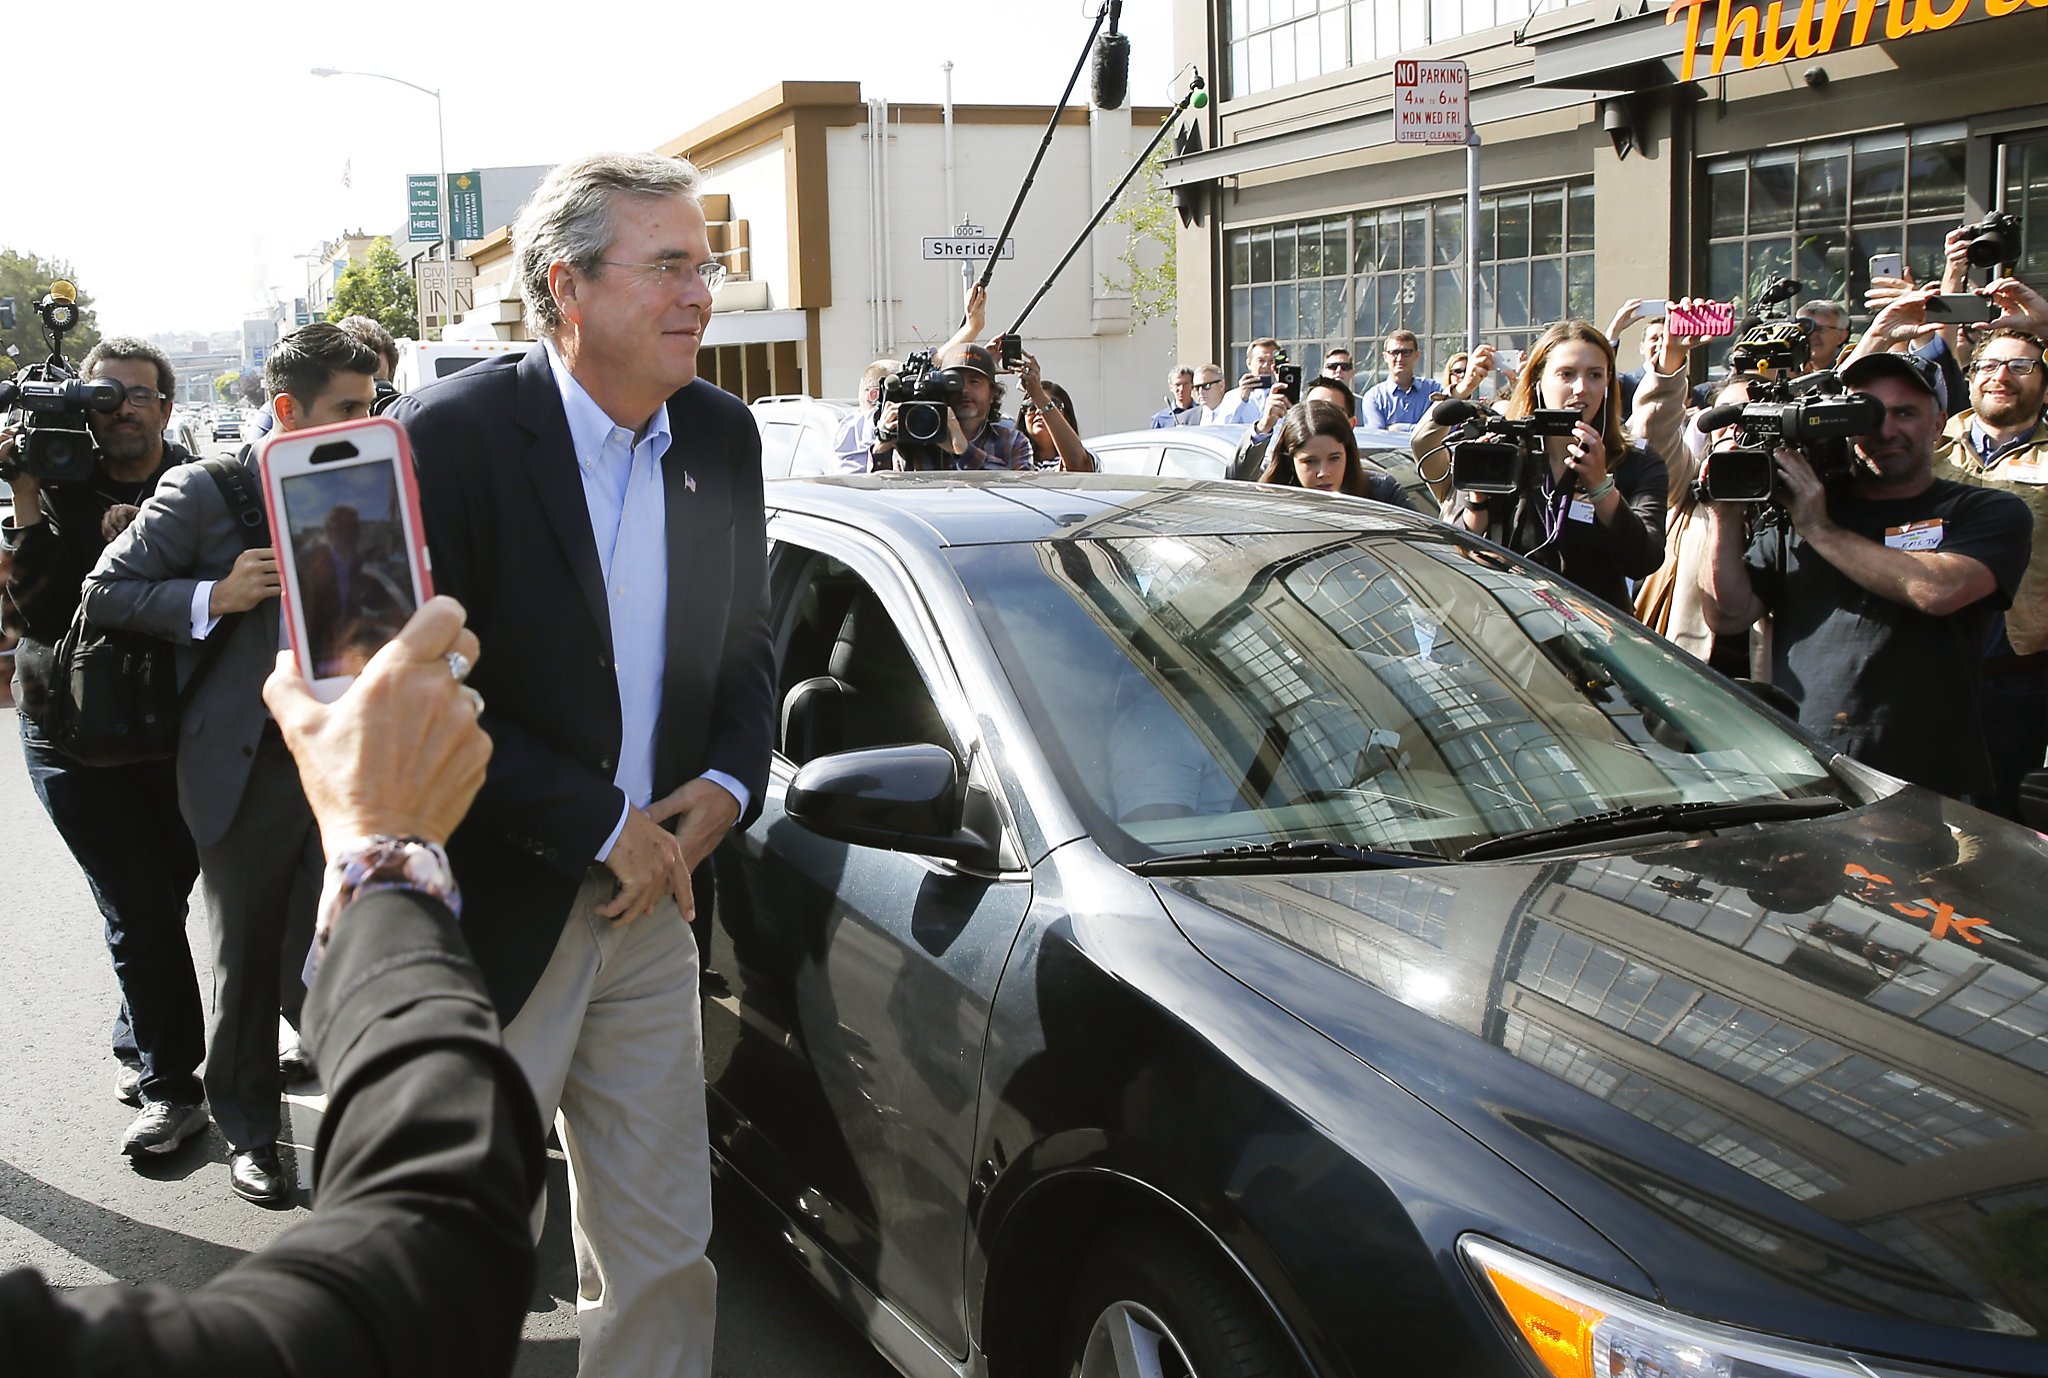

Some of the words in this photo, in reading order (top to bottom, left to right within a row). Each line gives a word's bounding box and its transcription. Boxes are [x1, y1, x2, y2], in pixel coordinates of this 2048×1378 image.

[1397, 63, 1416, 84] NO
[1420, 68, 1463, 84] PARKING
[1402, 111, 1422, 124] MON
[1425, 111, 1443, 124] WED
[1446, 111, 1460, 124] FRI
[1401, 131, 1426, 140] STREET
[1429, 131, 1462, 140] CLEANING
[412, 220, 437, 229] HERE
